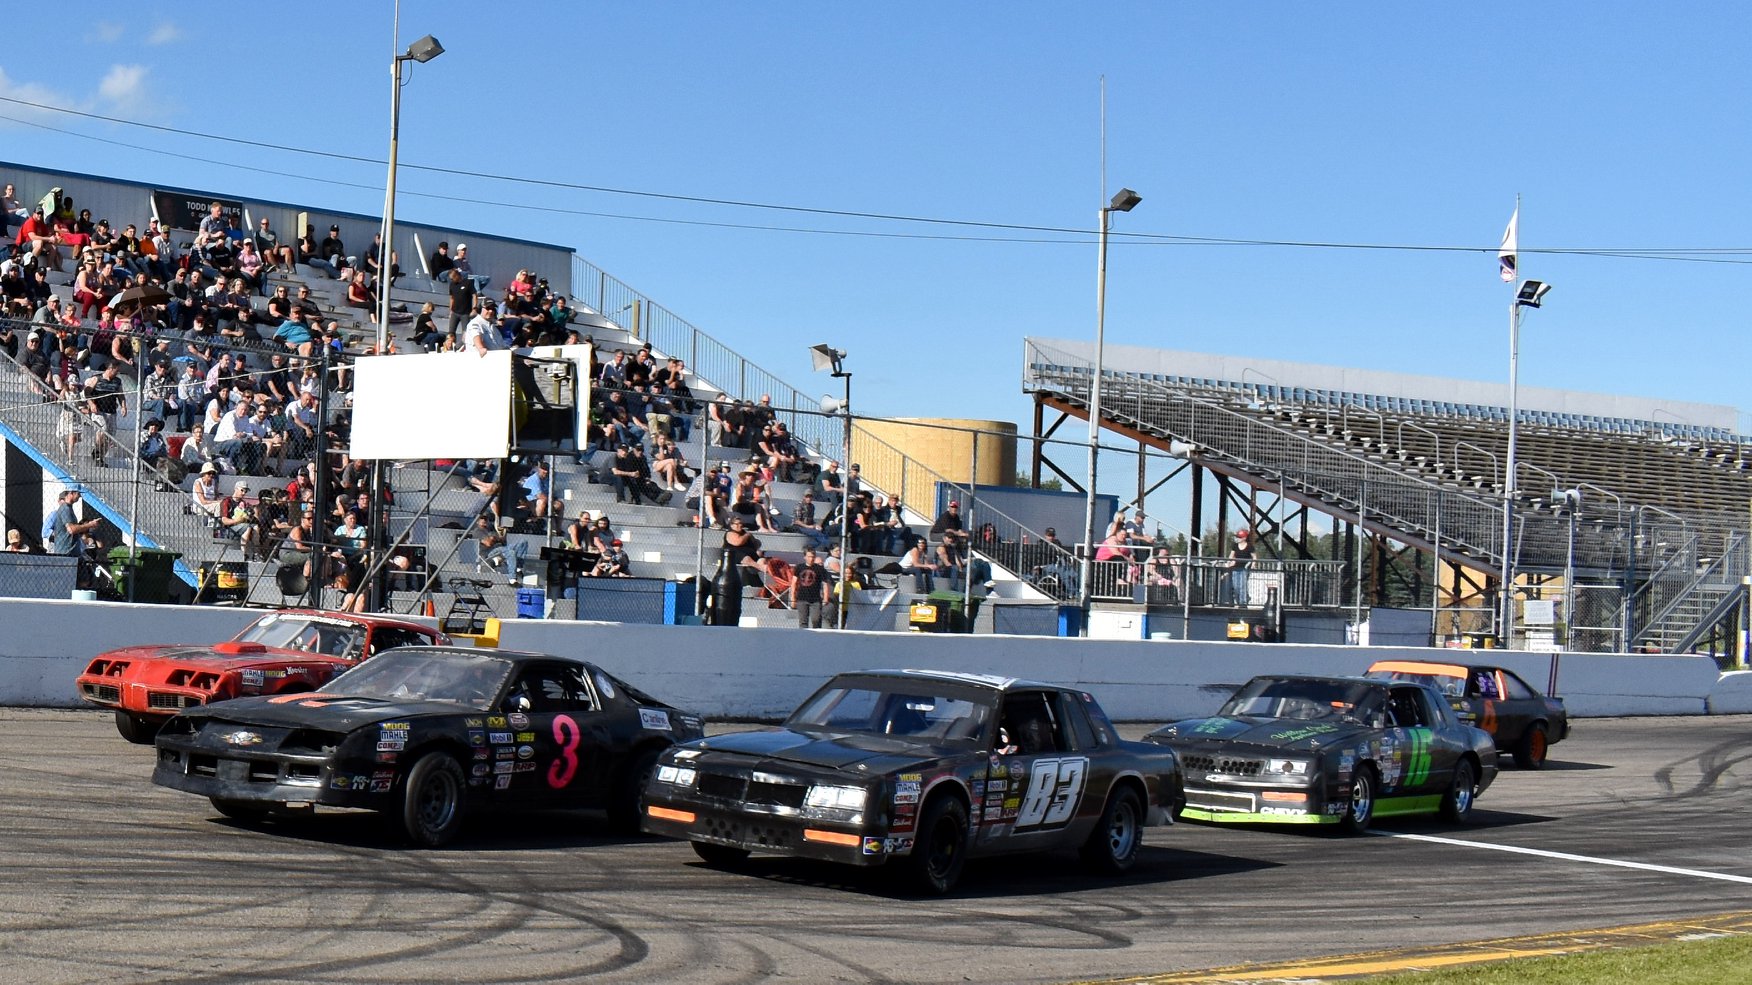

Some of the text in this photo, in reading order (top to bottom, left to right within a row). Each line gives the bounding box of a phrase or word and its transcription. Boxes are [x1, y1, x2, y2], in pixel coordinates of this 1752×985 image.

[187, 201, 206, 211] TODD
[265, 670, 286, 678] MOOG
[383, 722, 410, 730] MOOG
[381, 731, 408, 740] MAHLE
[548, 714, 580, 789] 3
[1403, 728, 1434, 786] 16
[899, 773, 922, 782] MOOG
[896, 782, 920, 793] MAHLE
[1012, 757, 1089, 835] 83
[1260, 805, 1307, 815] CHEVY
